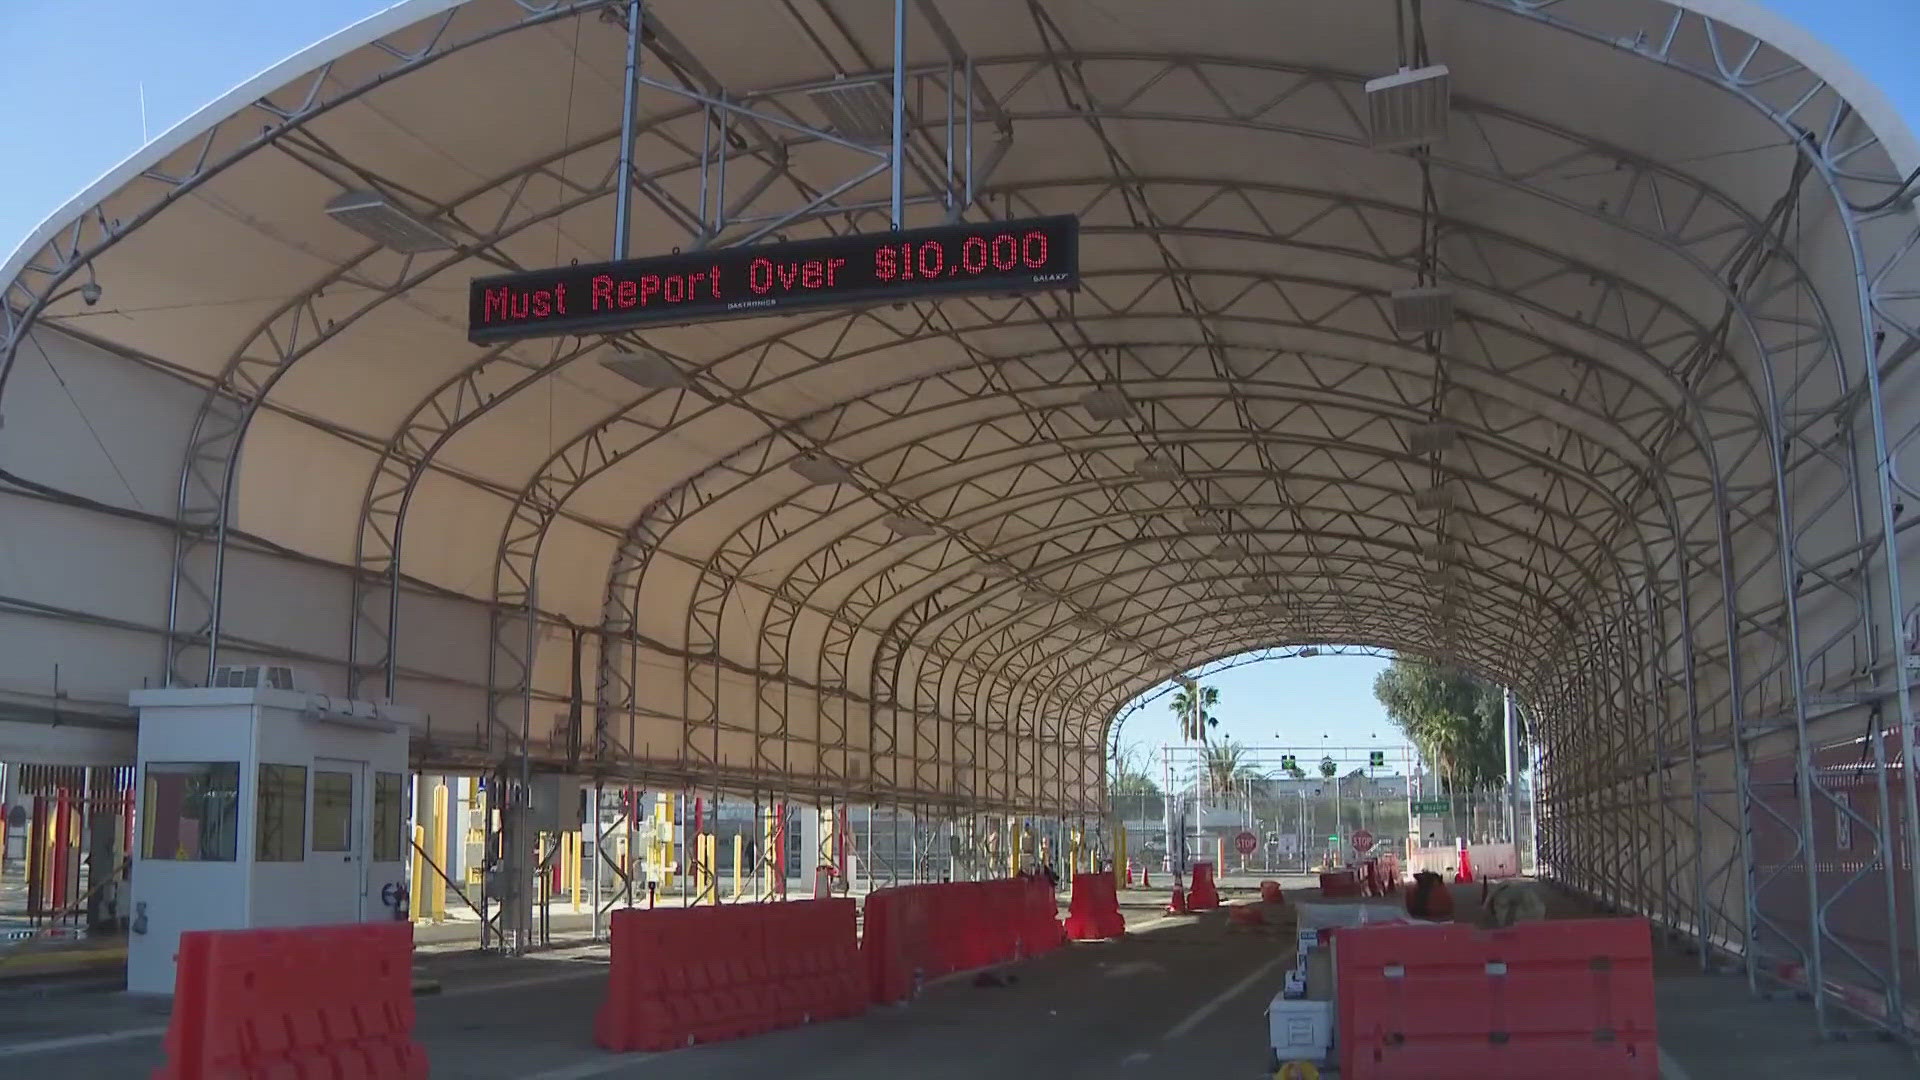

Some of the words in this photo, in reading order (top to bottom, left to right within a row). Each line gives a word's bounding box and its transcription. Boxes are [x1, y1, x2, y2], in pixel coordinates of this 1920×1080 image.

[485, 282, 567, 323] Must
[750, 257, 846, 295] Over
[875, 230, 1049, 283] $10,000
[1033, 273, 1067, 283] GALAXY
[1236, 837, 1256, 849] STOP
[1352, 836, 1372, 848] STOP
